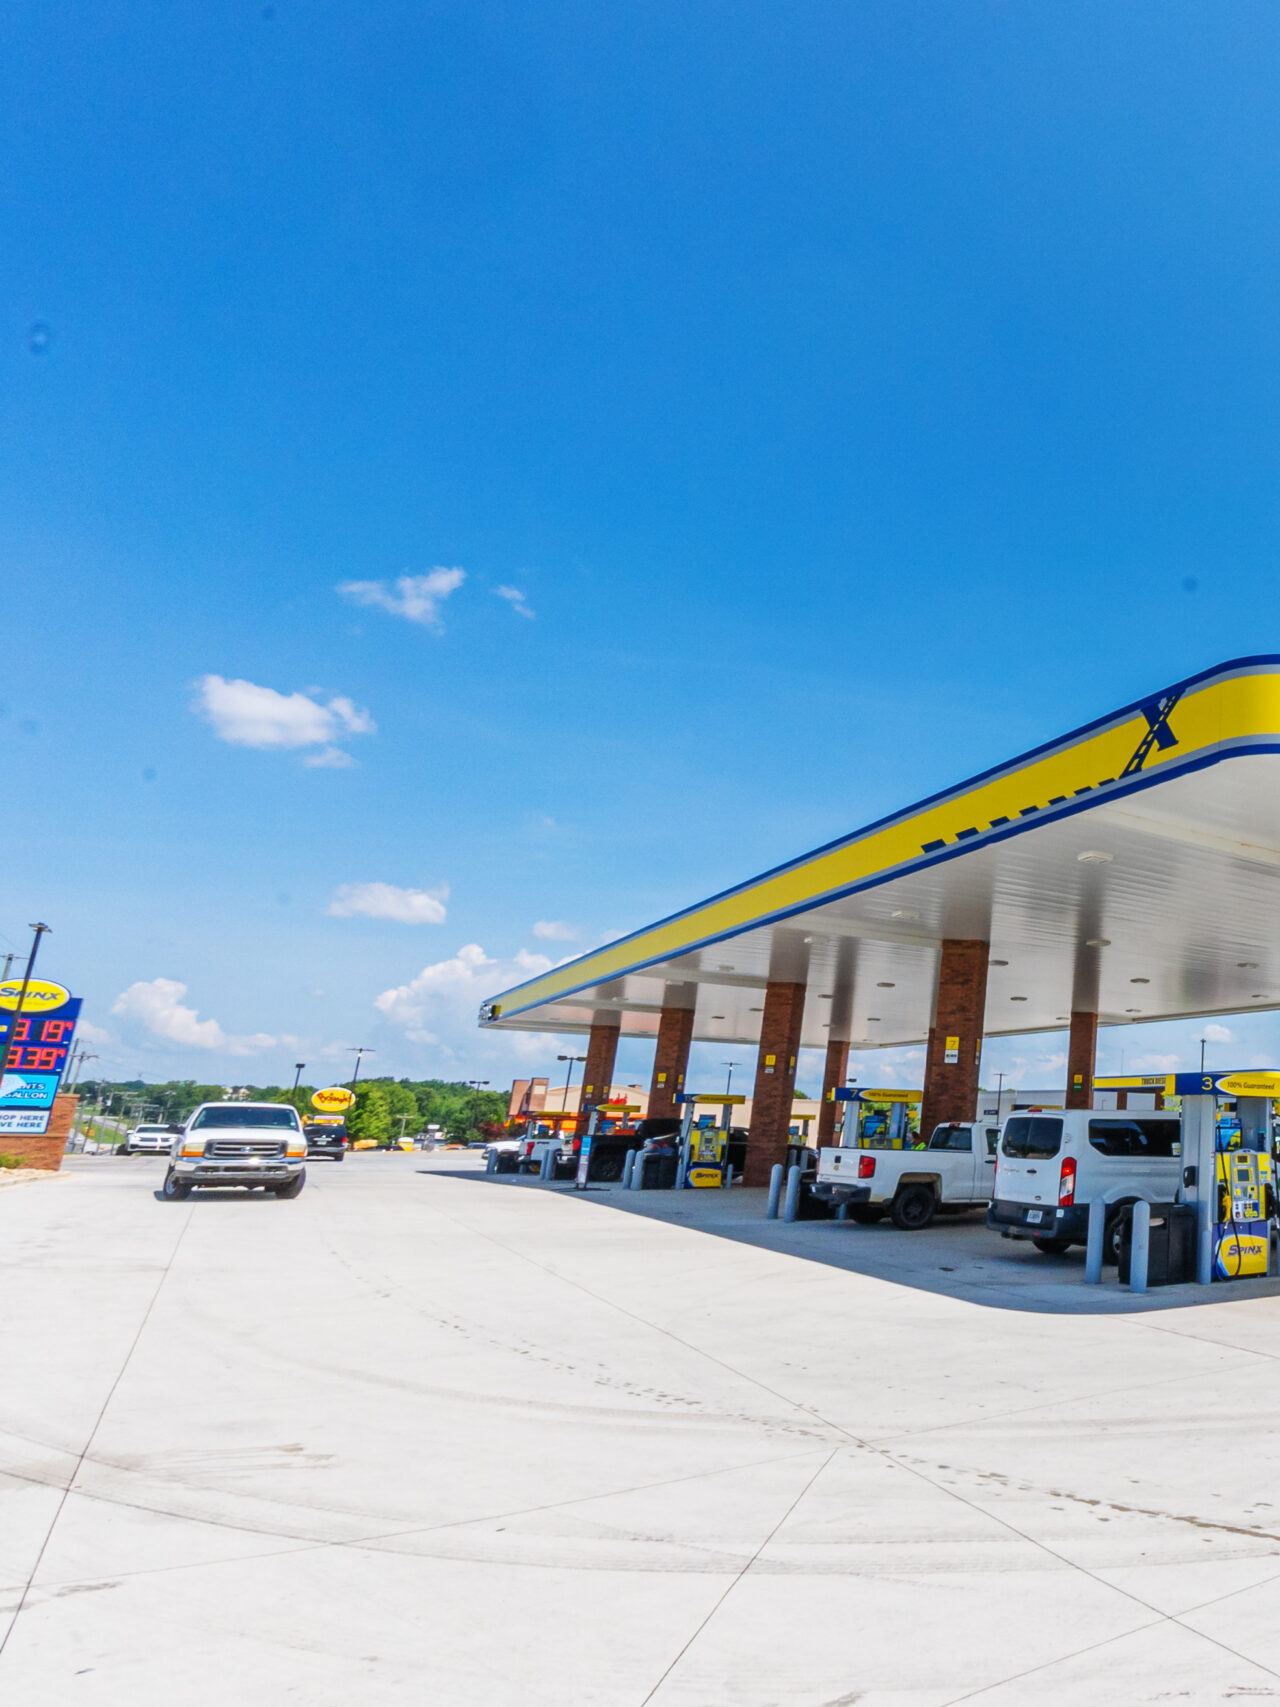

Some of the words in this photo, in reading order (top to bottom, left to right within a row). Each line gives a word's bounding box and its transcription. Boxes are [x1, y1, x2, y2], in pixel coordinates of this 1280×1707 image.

[1201, 1076, 1213, 1091] 3
[1227, 1081, 1242, 1089] 100%
[1243, 1082, 1275, 1090] Guaranteed
[849, 1089, 858, 1098] 7
[1227, 1244, 1263, 1257] SPINX
